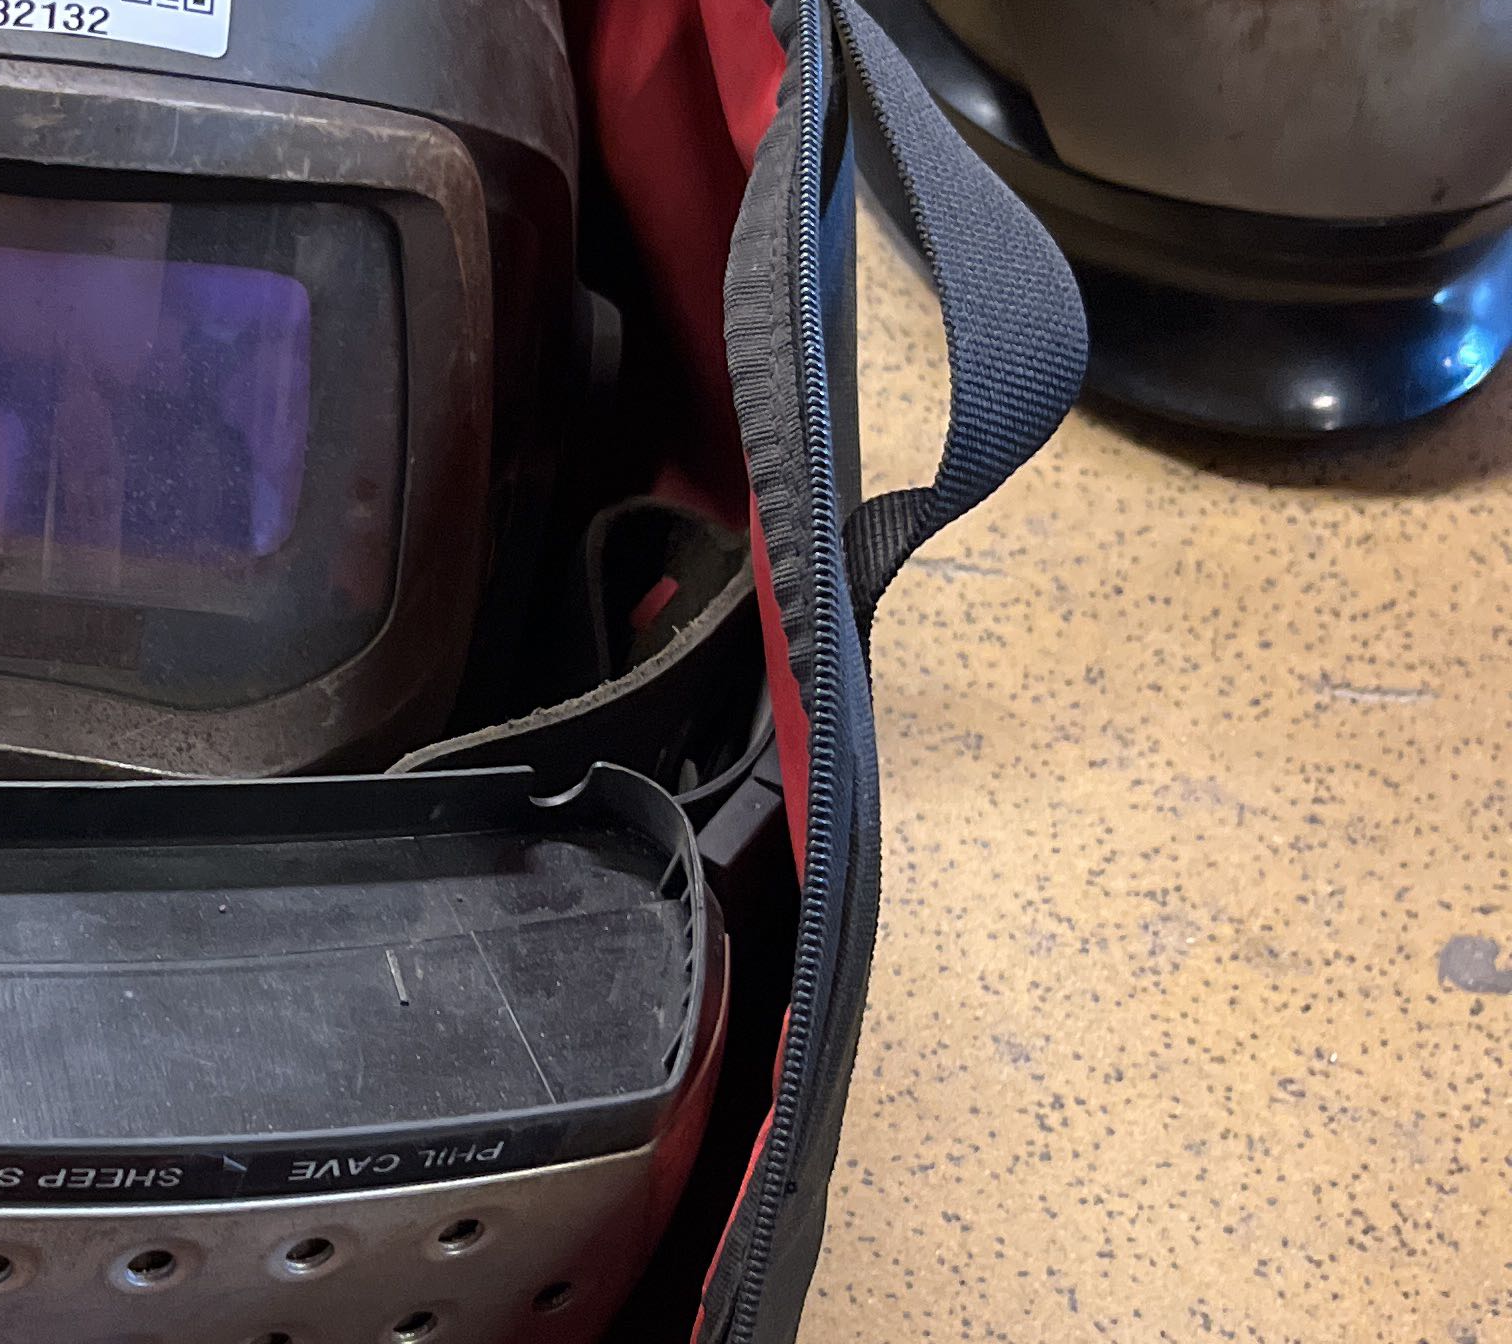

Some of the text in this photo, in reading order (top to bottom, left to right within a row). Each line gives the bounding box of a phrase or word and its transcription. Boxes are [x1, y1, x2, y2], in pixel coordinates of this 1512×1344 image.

[288, 1140, 505, 1181] PHIL CAVE
[37, 1166, 185, 1189] SHEEP
